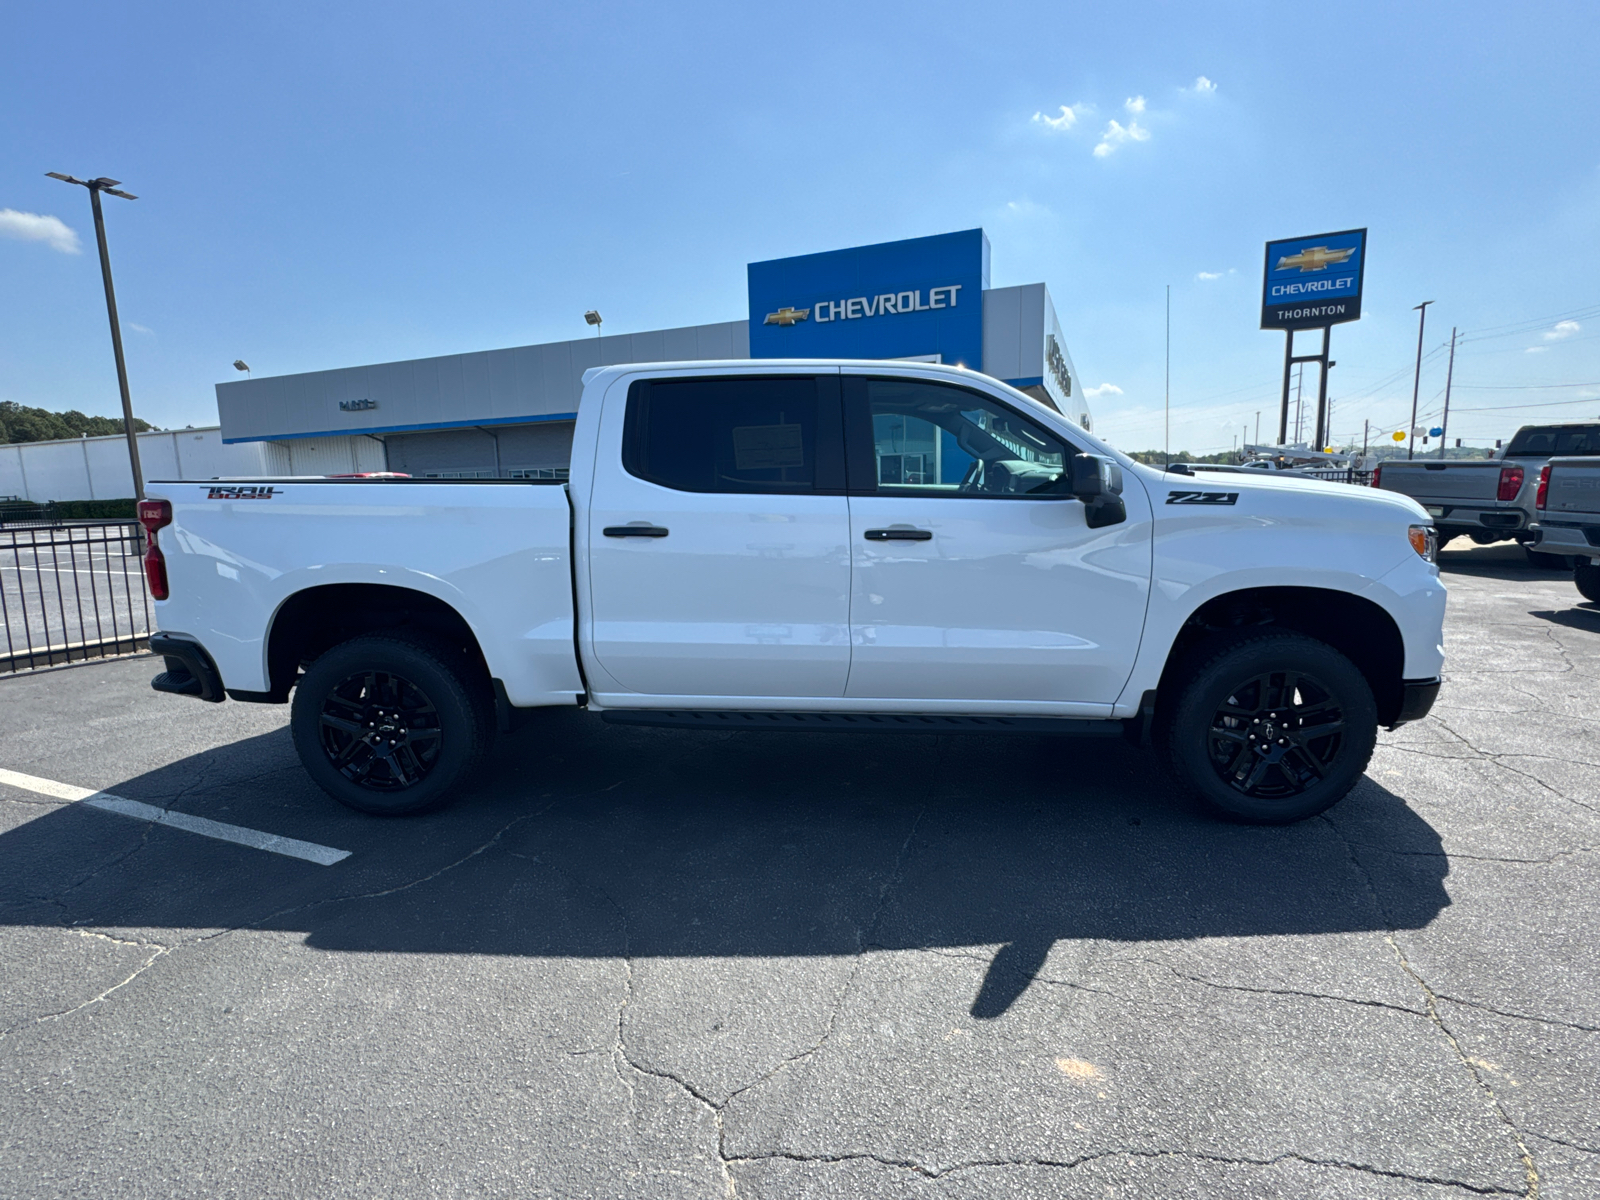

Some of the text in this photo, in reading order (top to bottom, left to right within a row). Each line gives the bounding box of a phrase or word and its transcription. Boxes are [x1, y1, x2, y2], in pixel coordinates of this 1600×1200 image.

[1271, 277, 1354, 296] CHEVROLET
[814, 284, 963, 323] CHEVROLET
[1277, 304, 1346, 320] THORNTON
[1165, 490, 1240, 506] Z71
